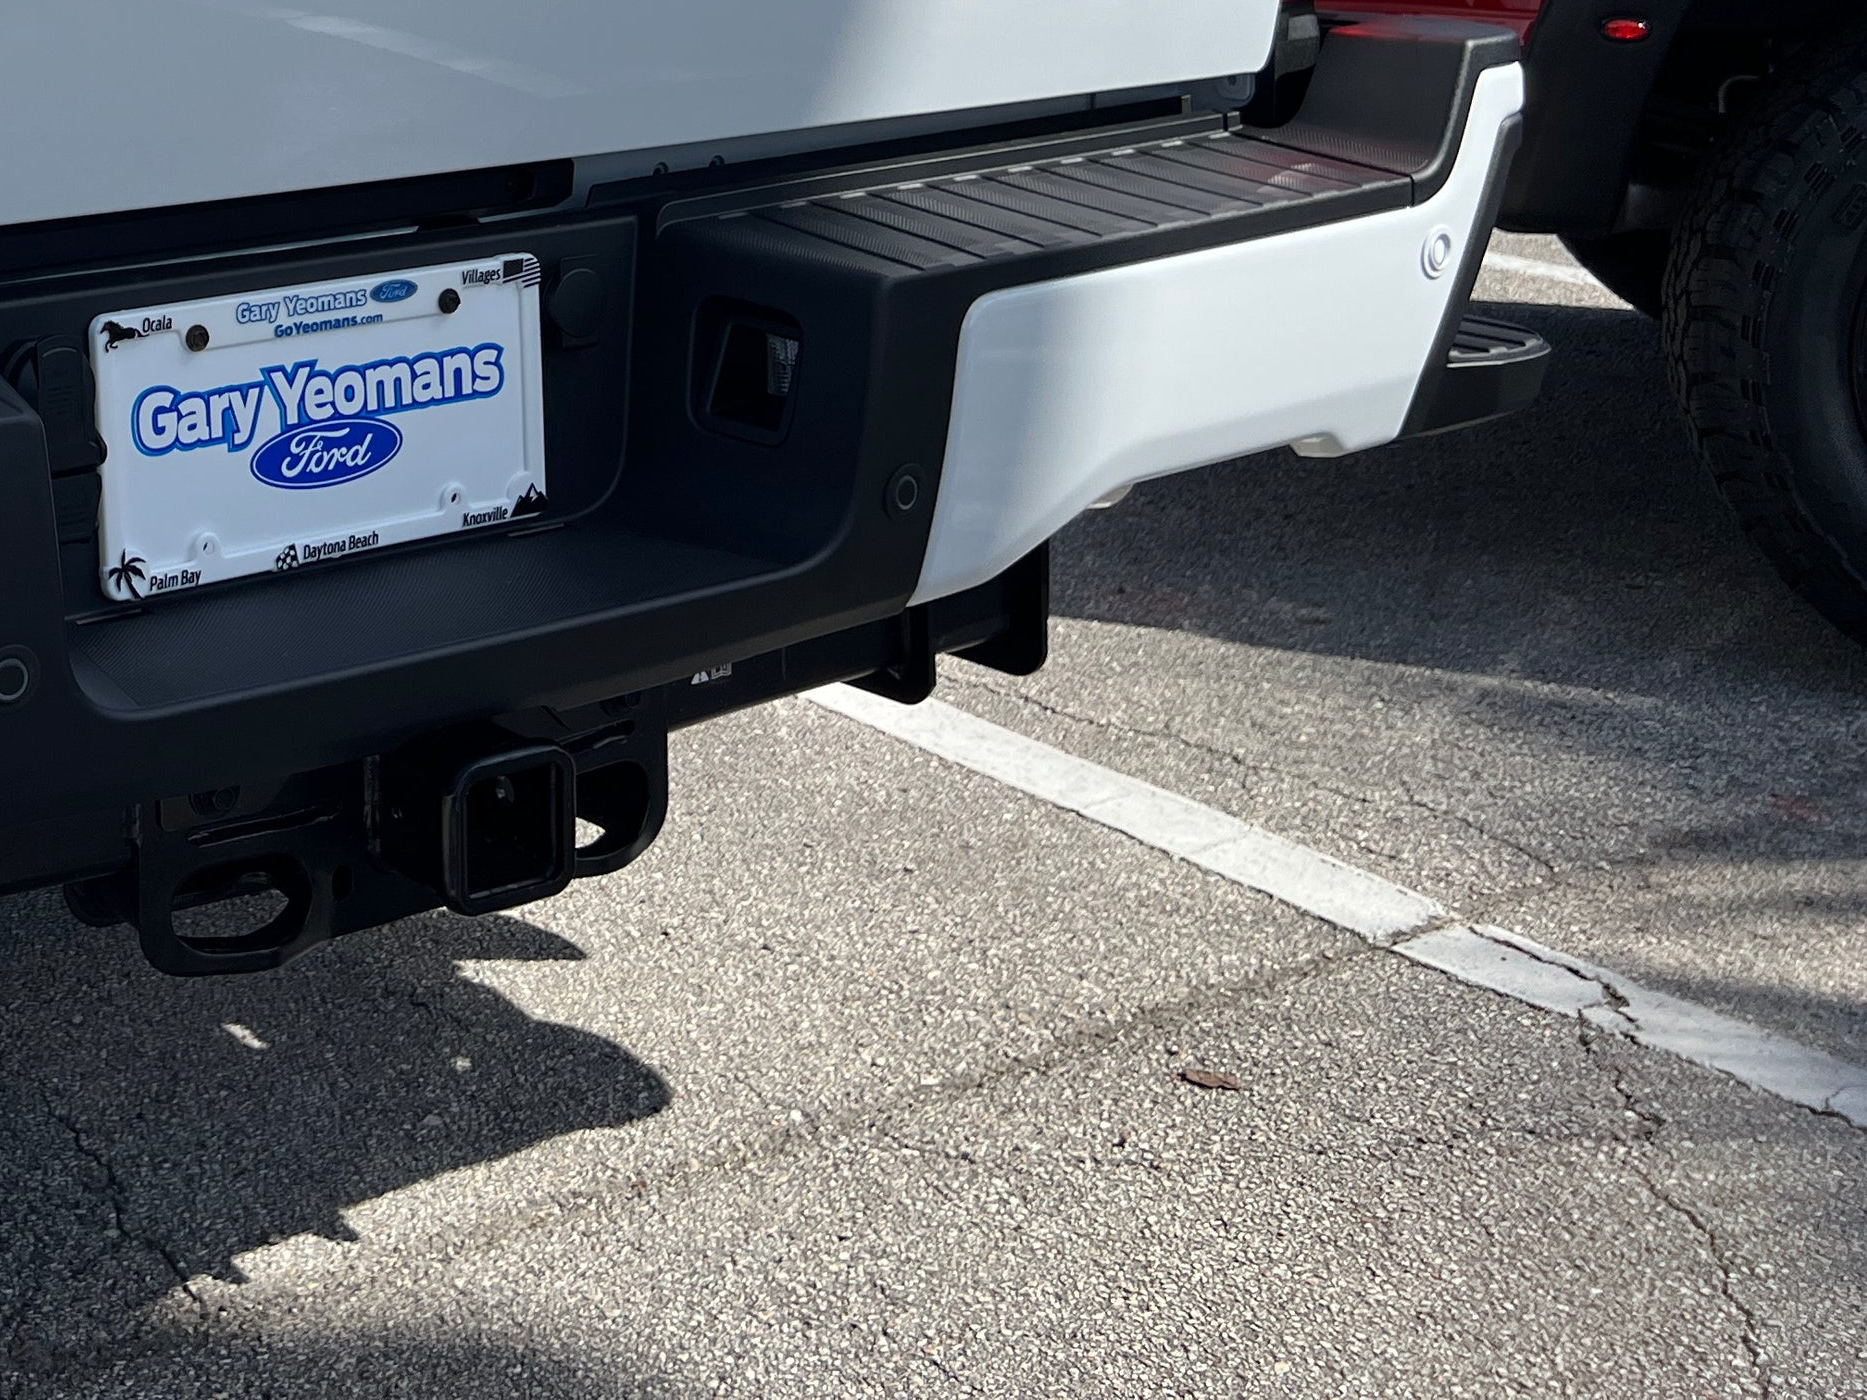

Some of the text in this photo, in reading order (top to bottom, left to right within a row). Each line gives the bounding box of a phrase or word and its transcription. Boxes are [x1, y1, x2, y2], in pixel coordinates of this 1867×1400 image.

[461, 268, 502, 286] Villages
[236, 288, 367, 324] Gary Yeomans
[142, 314, 173, 333] Ocala
[274, 313, 383, 338] GoYeomans.com
[134, 346, 503, 453] Gary Yeomans
[280, 426, 373, 478] Ford
[461, 506, 509, 528] Knoxville
[303, 531, 379, 560] Daytona Beach
[149, 568, 202, 591] Palm Bay
